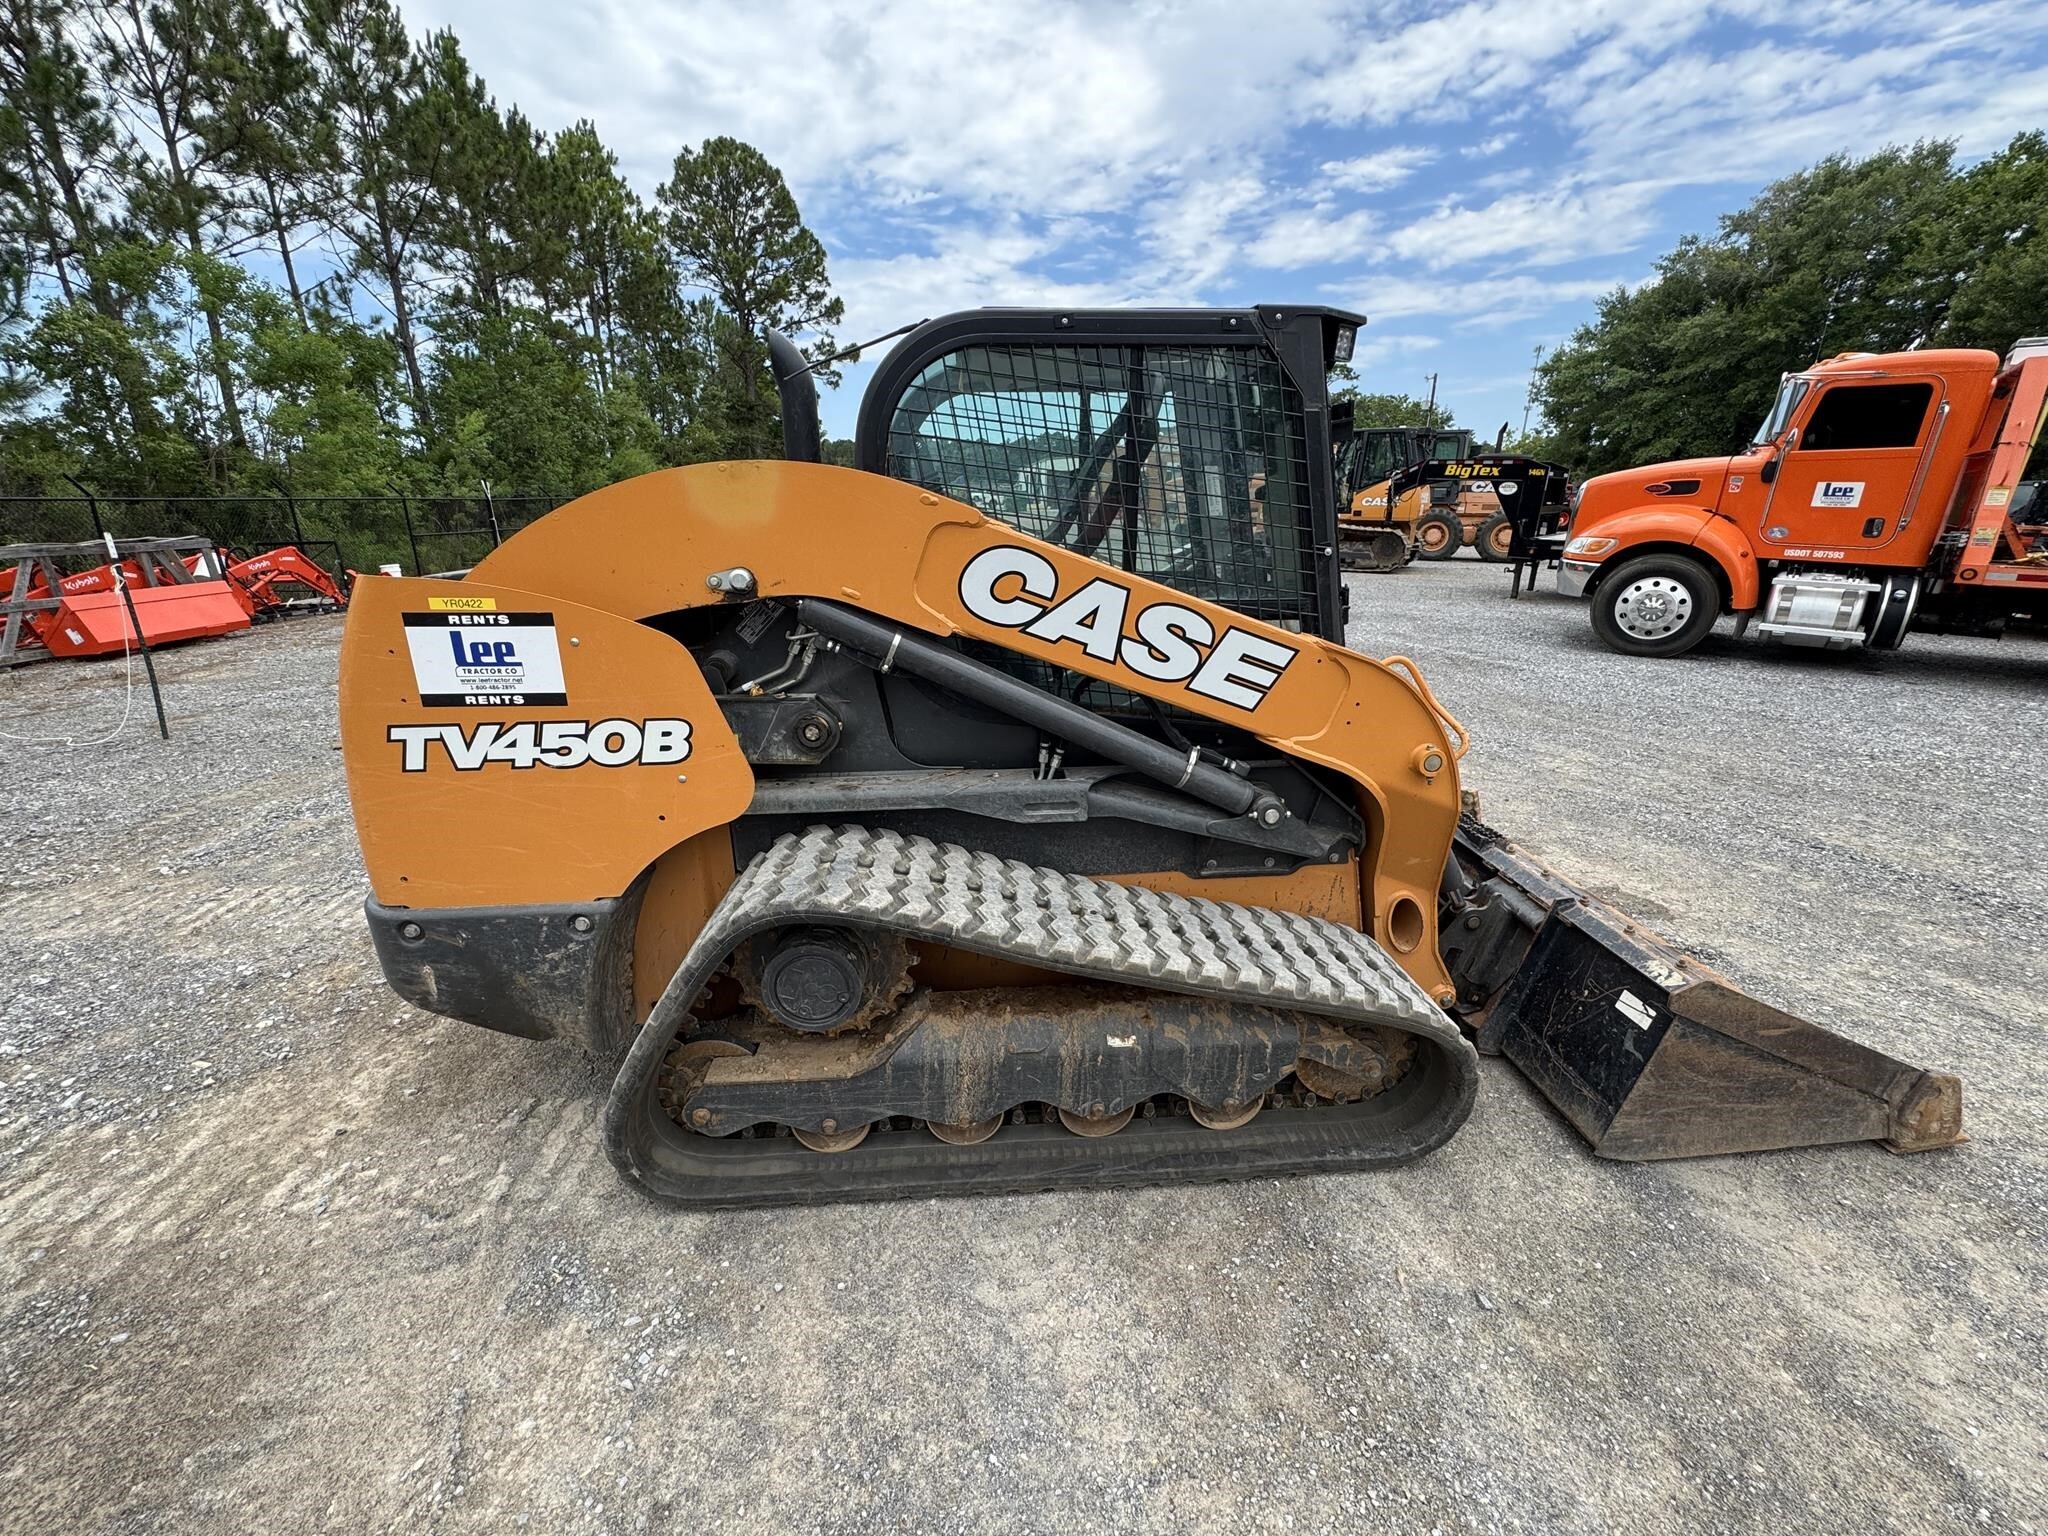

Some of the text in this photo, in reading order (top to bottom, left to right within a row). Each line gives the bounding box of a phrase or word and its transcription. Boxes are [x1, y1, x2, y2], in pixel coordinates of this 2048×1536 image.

[1471, 480, 1496, 493] CA
[1783, 548, 1812, 557] USDOT
[64, 575, 100, 590] Kubota
[441, 598, 484, 609] YR0422
[447, 614, 510, 625] RENTS
[958, 544, 1300, 712] CASE
[464, 695, 525, 705] RENTS
[387, 717, 693, 772] TV450B
